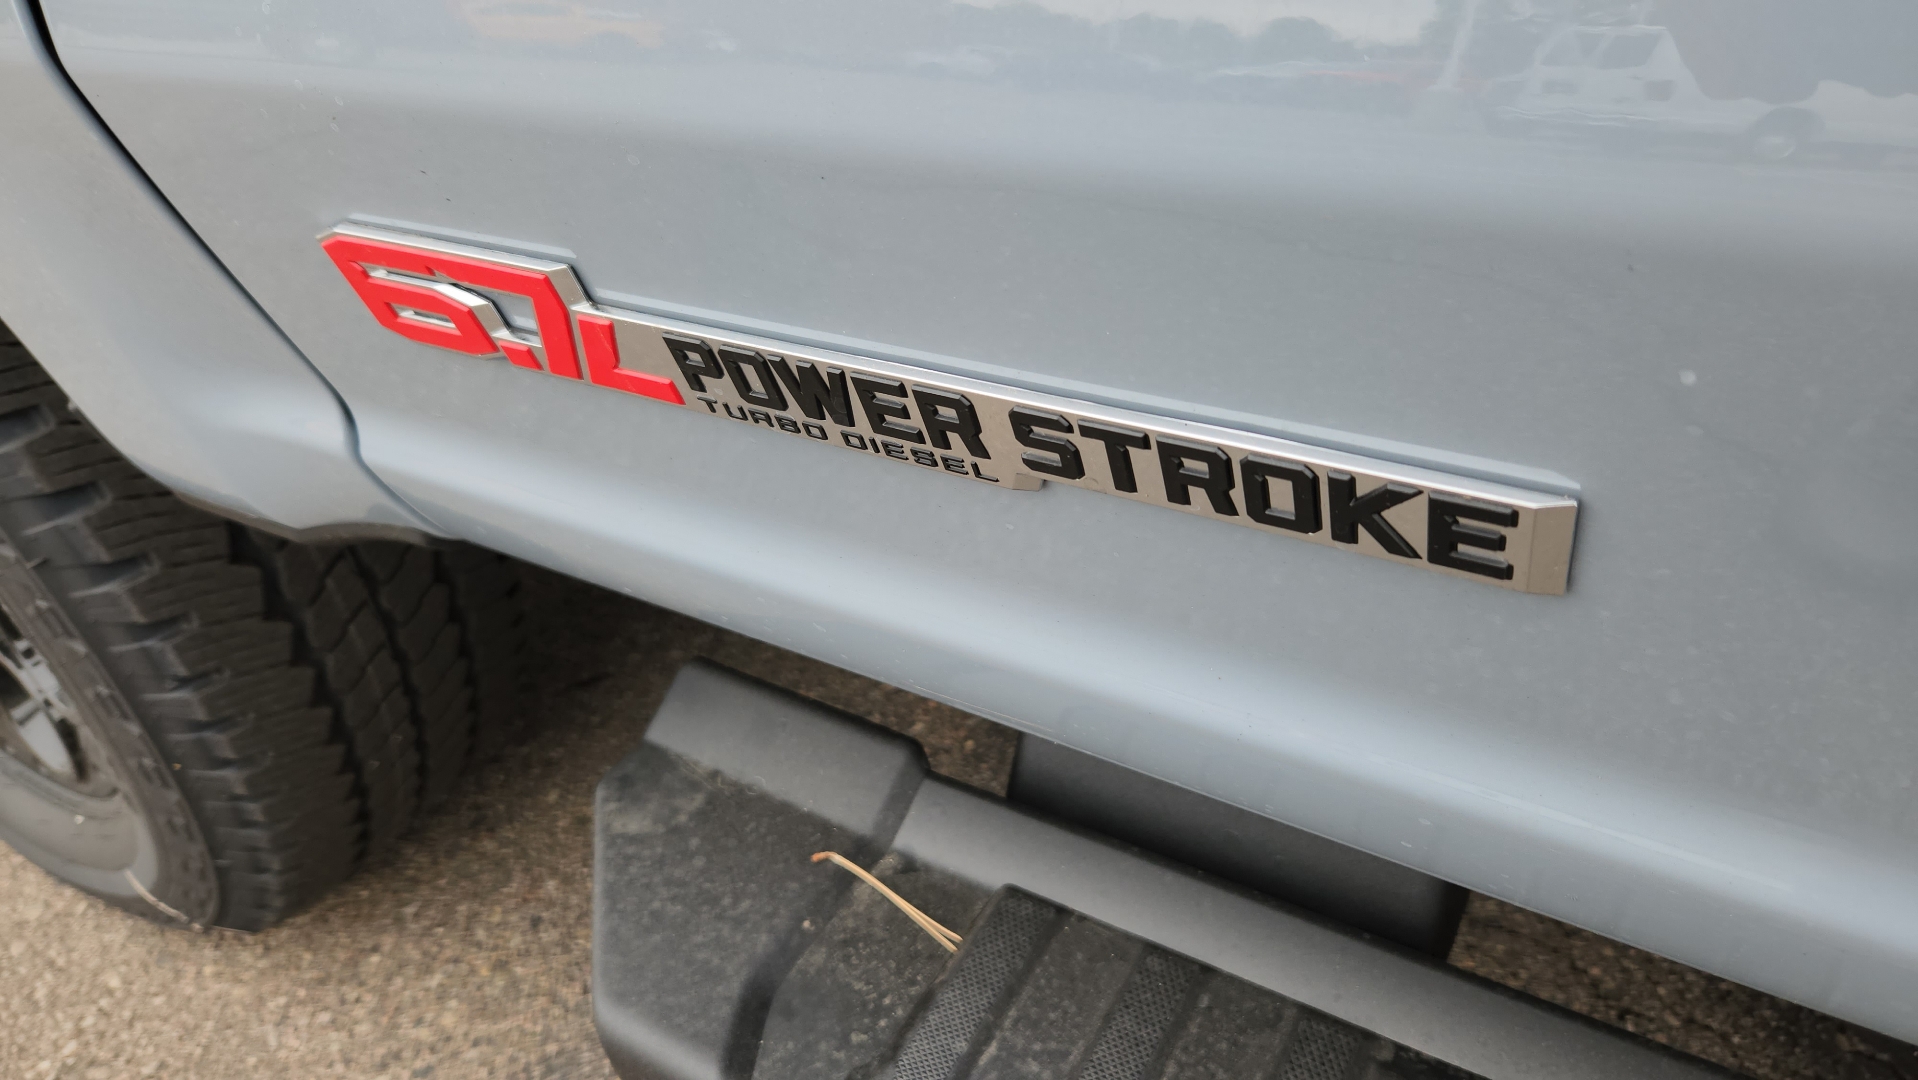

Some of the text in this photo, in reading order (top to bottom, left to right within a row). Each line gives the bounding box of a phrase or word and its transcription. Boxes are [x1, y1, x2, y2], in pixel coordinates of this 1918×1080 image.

[321, 234, 1519, 581] 6.7L POWER STROKE
[697, 394, 1000, 483] TURBO DIESEL
